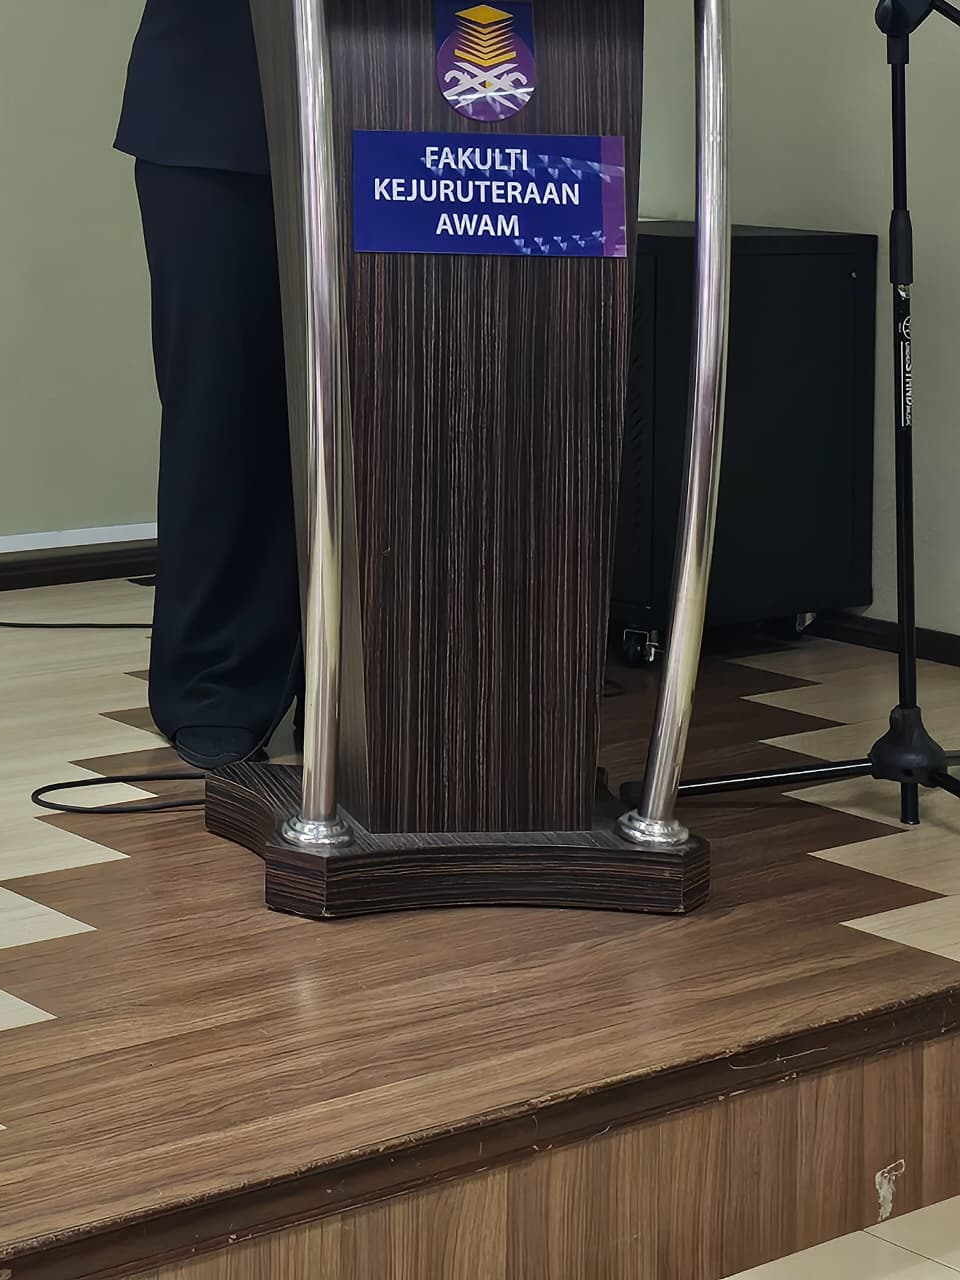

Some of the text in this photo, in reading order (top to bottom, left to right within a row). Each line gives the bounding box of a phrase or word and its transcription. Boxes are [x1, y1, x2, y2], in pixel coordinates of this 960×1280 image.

[425, 147, 527, 170] FAKULTI
[374, 178, 579, 205] KEJURUTERAAN
[436, 213, 519, 237] AWAM
